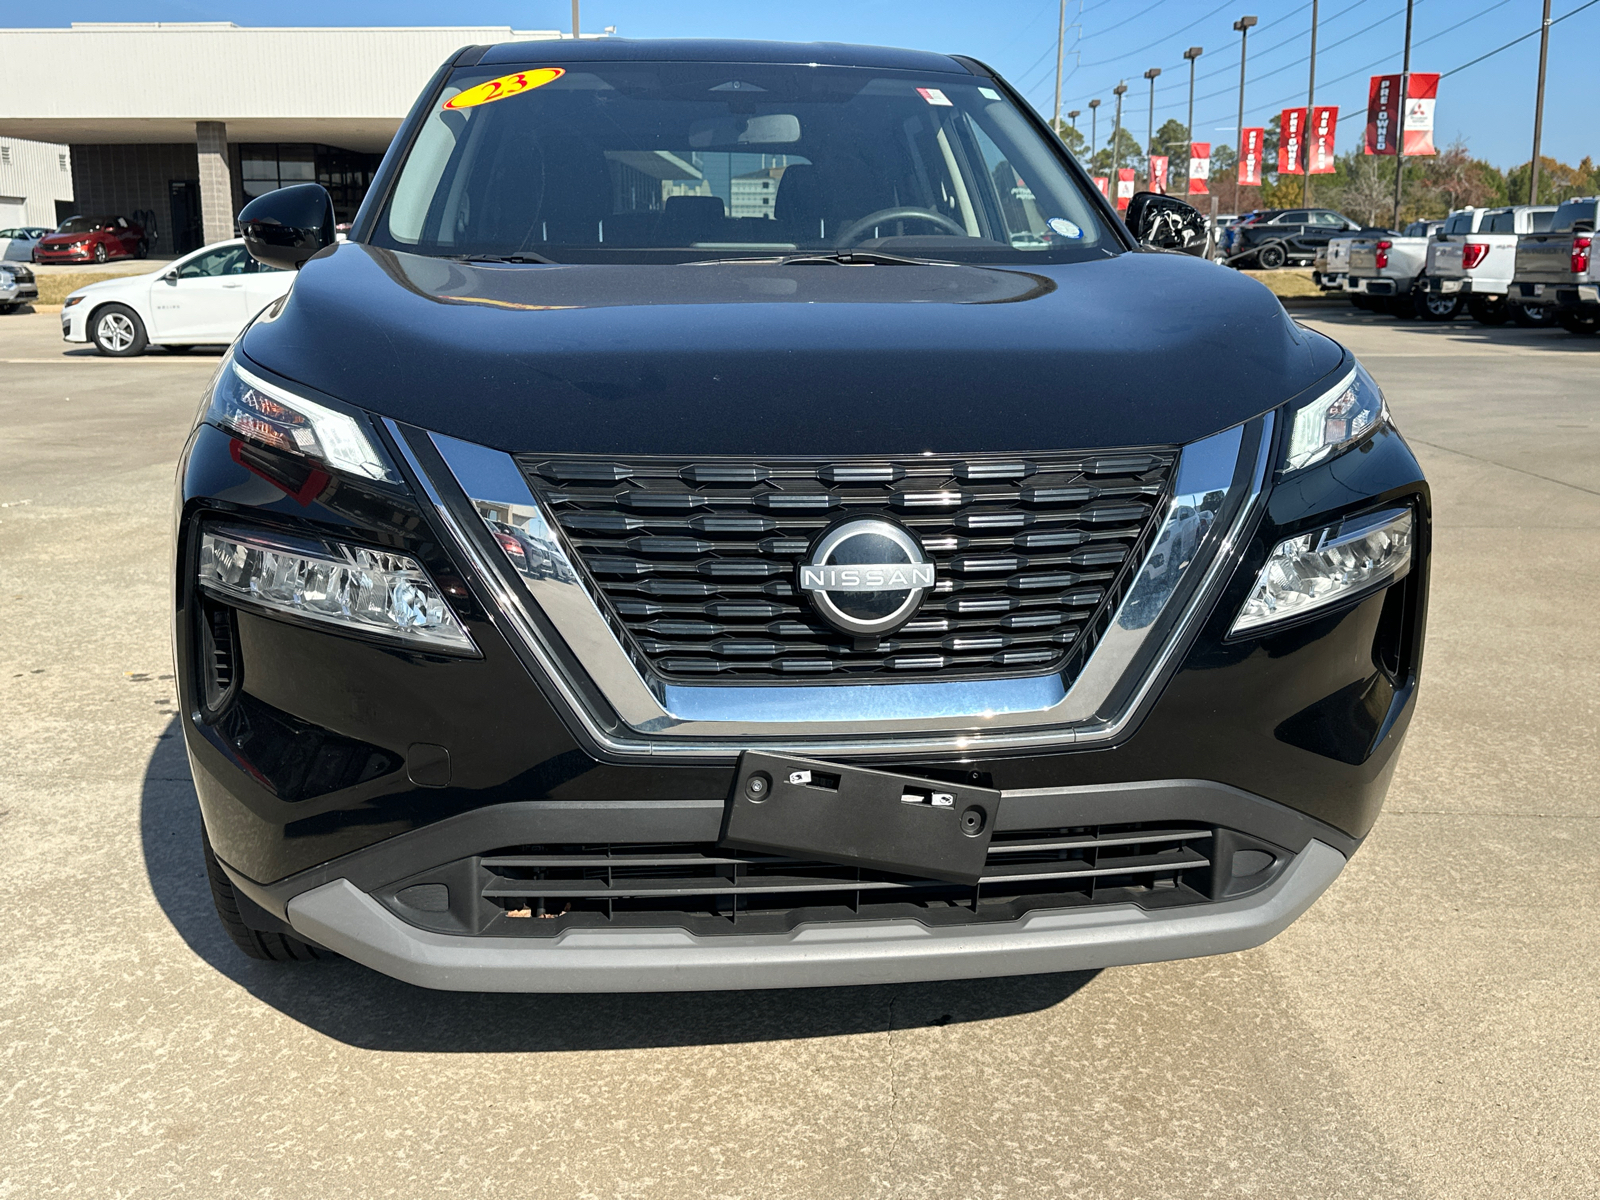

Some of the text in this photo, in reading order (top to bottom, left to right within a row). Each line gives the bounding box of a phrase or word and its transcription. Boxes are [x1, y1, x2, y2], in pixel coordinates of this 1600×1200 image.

[481, 74, 528, 102] 23
[1376, 80, 1390, 150] PRE-OWNED
[1287, 112, 1298, 171] PRE-OWNED
[805, 568, 930, 586] NISSAN
